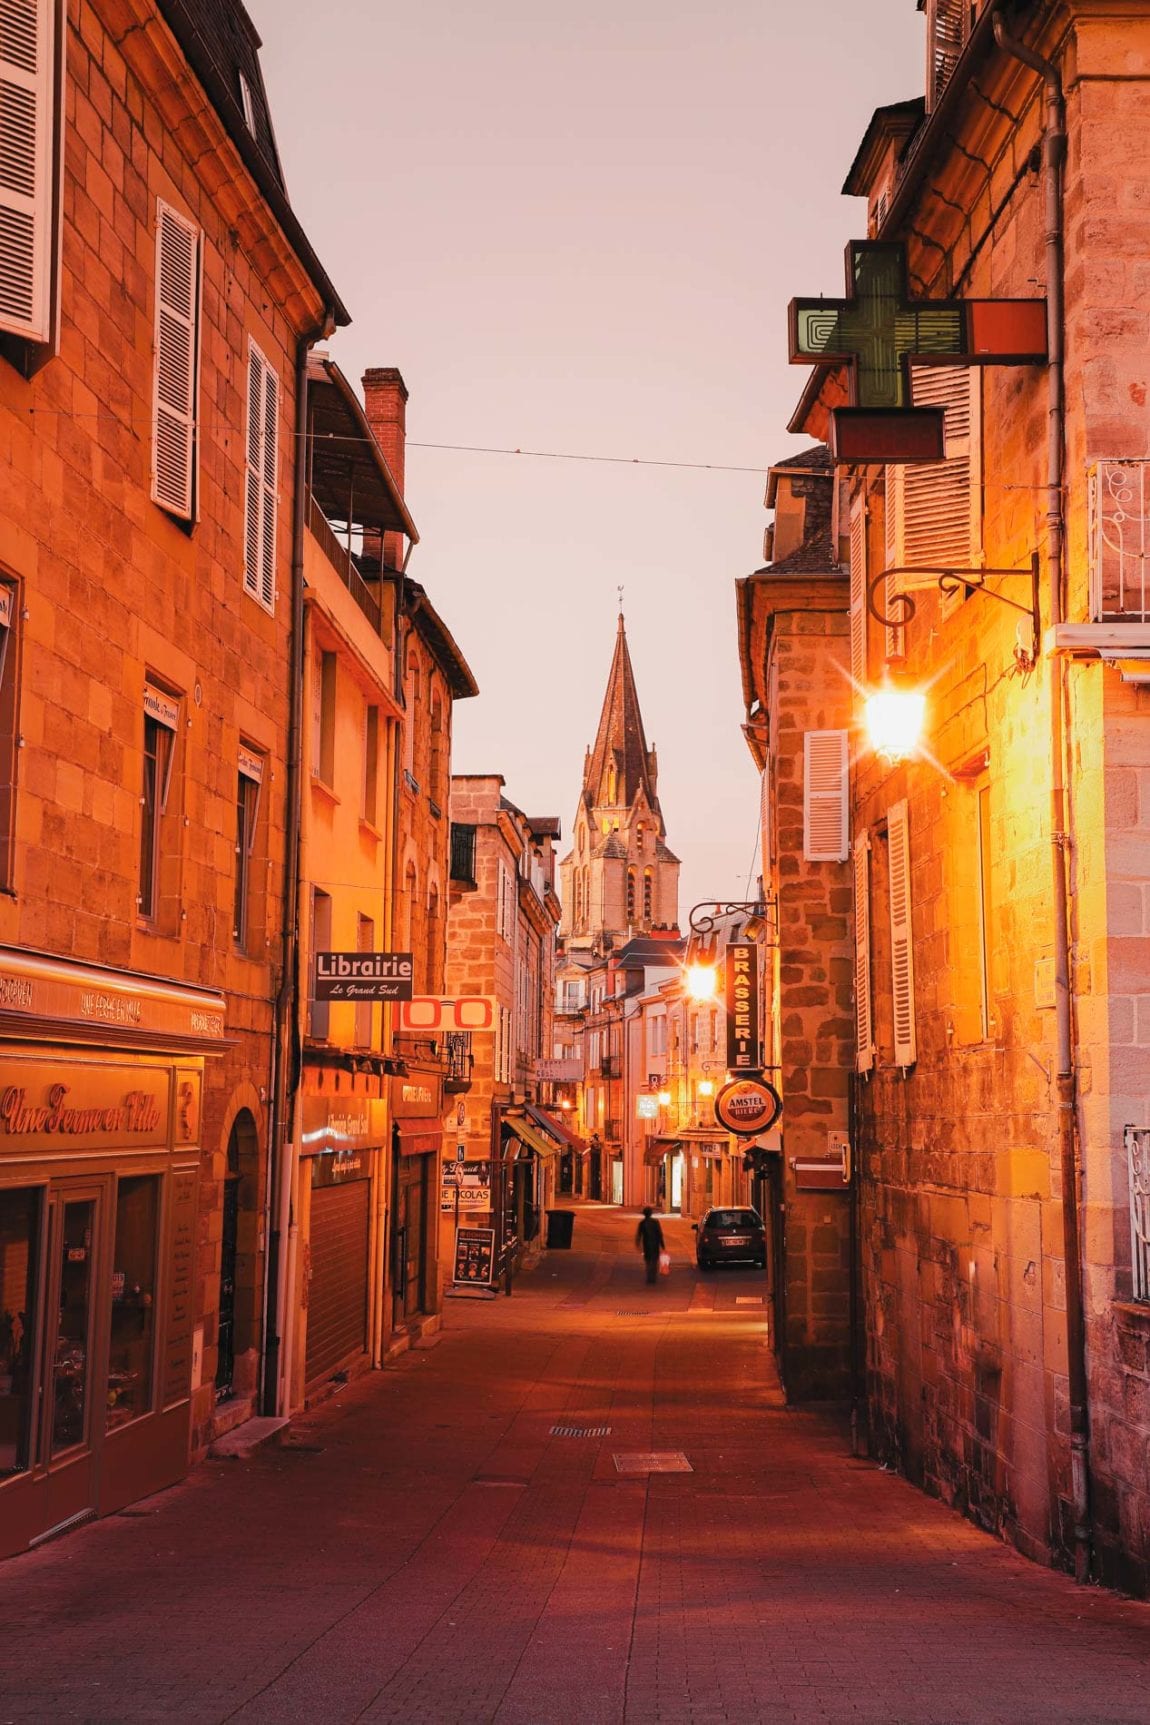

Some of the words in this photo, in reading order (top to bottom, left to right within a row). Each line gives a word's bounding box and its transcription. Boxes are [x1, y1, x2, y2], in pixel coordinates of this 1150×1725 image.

[317, 955, 412, 976] Librairie
[329, 984, 342, 994] Le
[346, 984, 375, 997] Grand
[377, 984, 399, 995] Sud
[733, 947, 750, 1066] BRASSERIE
[2, 1086, 48, 1135] Une
[44, 1083, 103, 1135] Ferme
[102, 1106, 124, 1133] en
[125, 1091, 161, 1132] Ville
[729, 1097, 764, 1108] AMSTEL
